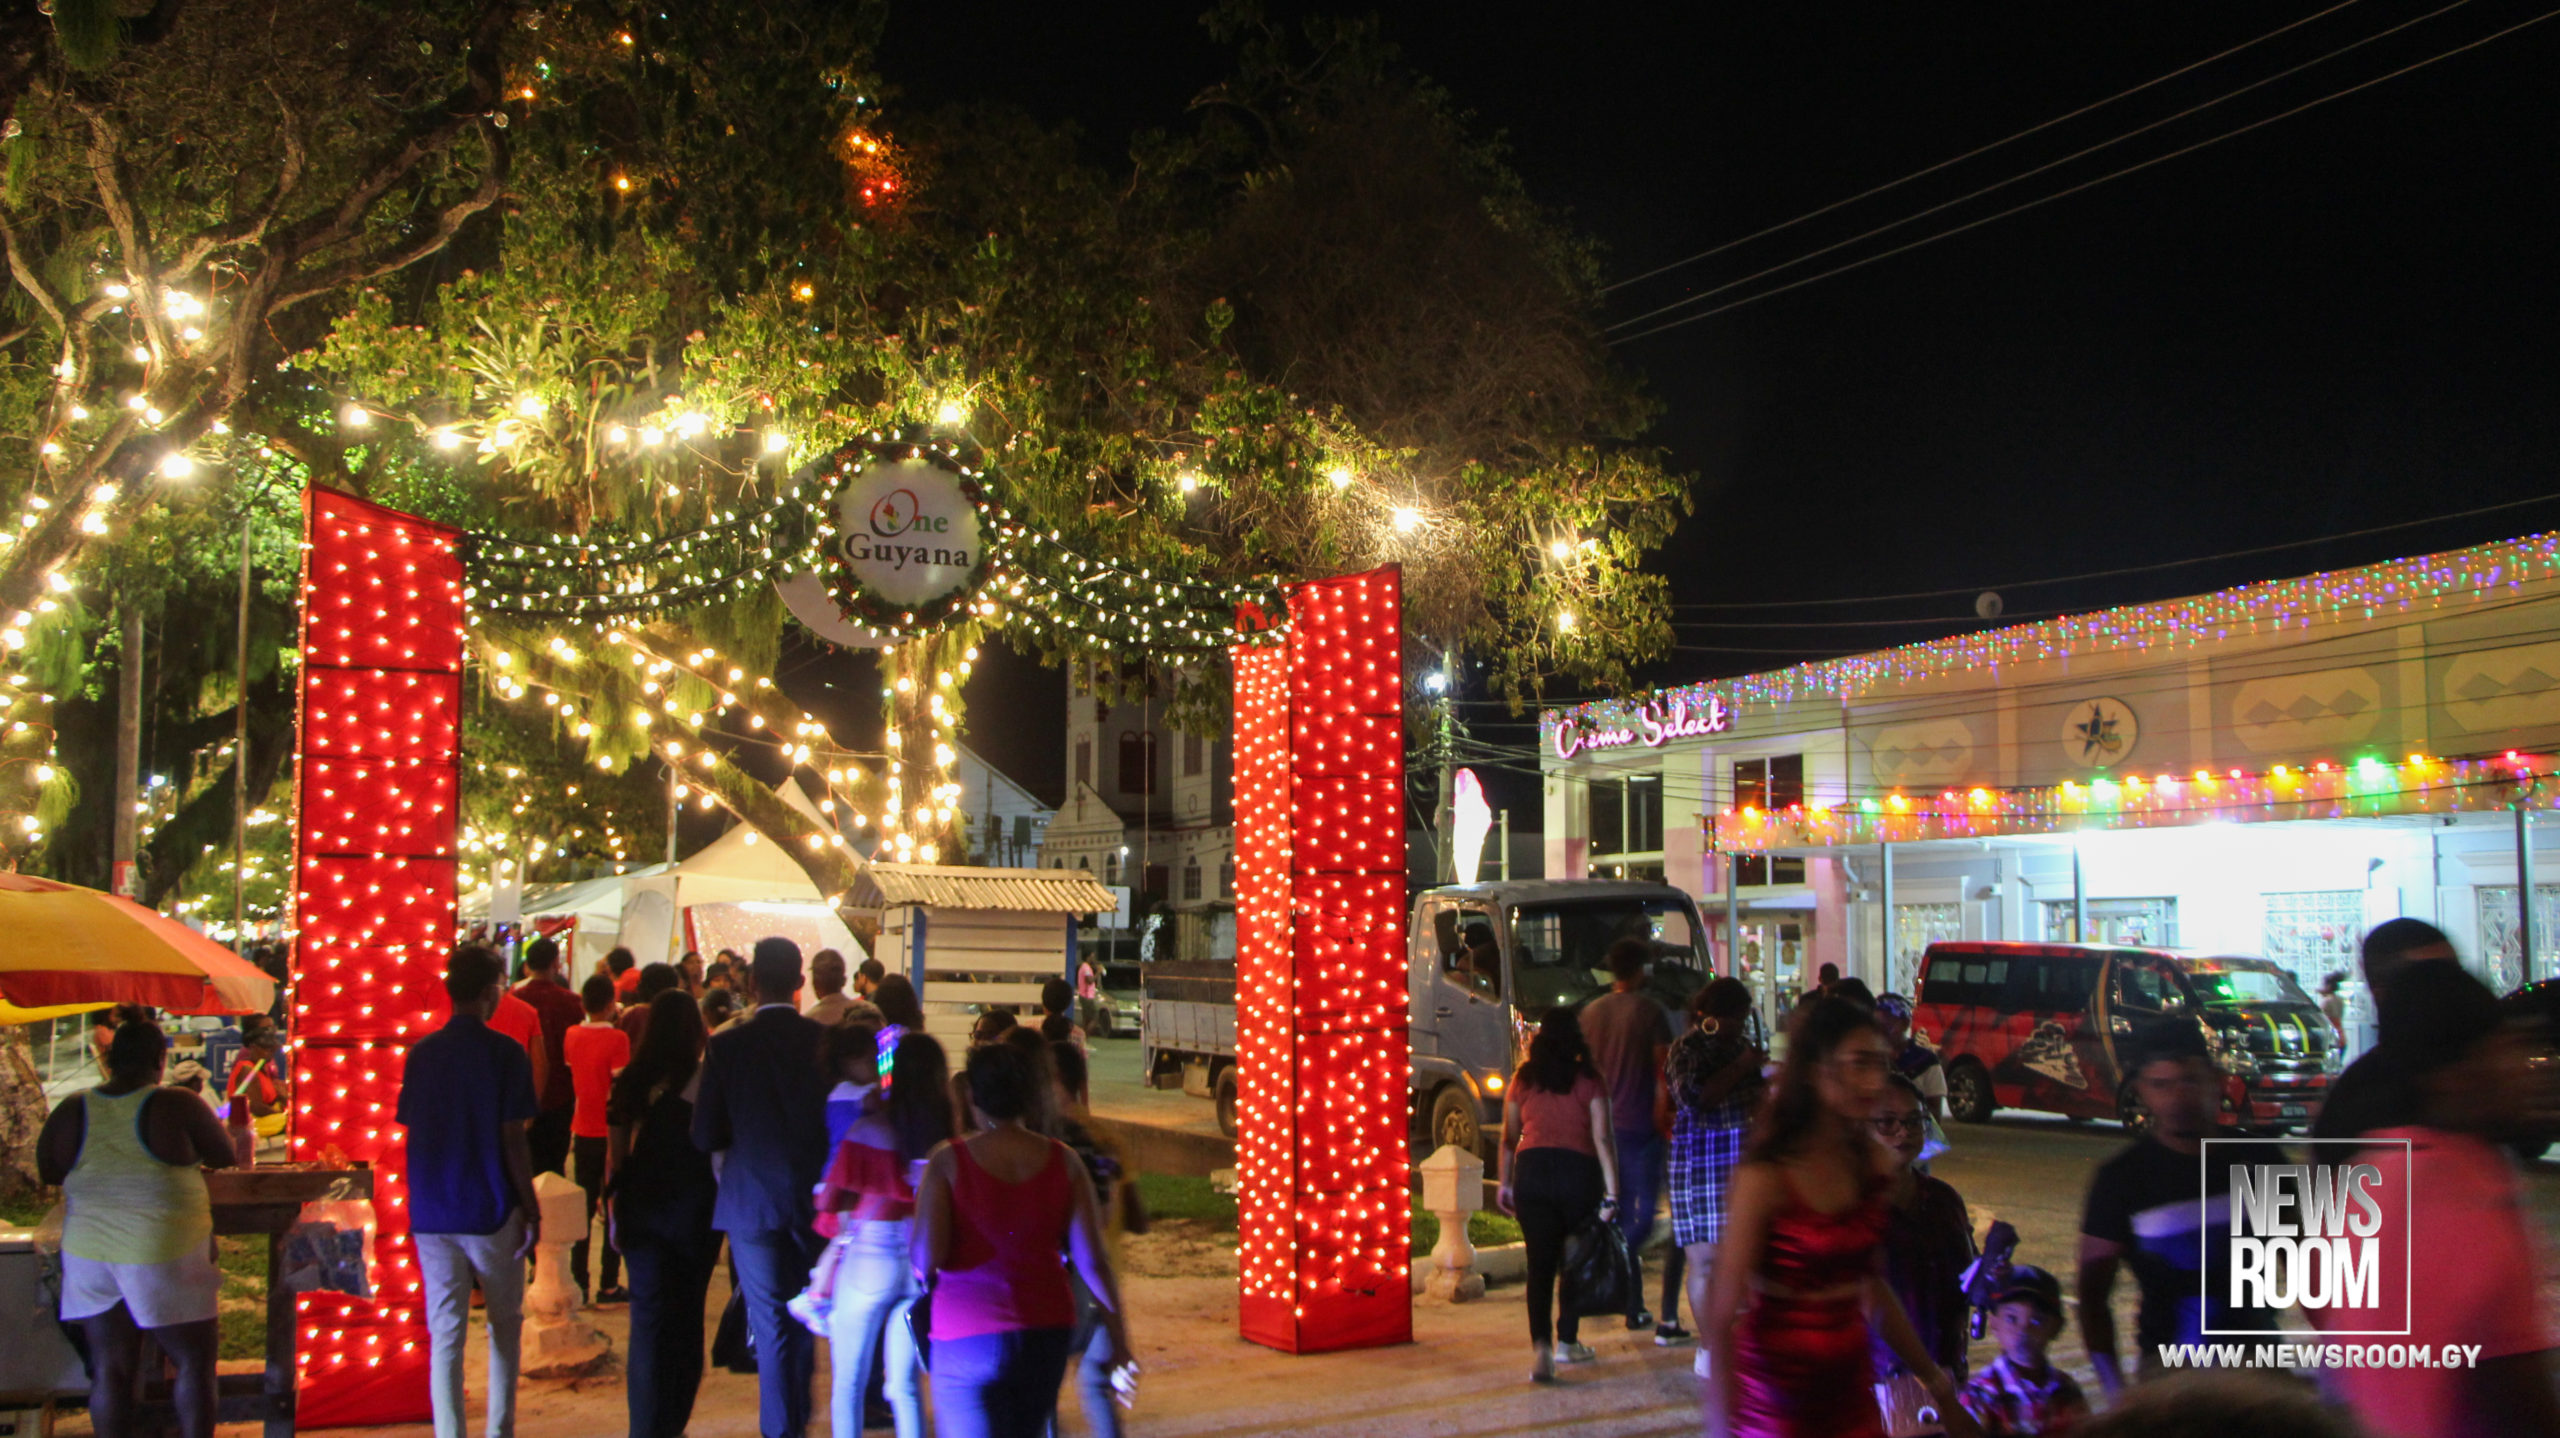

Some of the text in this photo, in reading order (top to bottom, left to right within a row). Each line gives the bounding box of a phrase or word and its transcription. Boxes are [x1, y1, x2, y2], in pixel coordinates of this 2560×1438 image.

[870, 488, 948, 537] One
[844, 533, 969, 570] Guyana
[1641, 698, 1726, 746] Select
